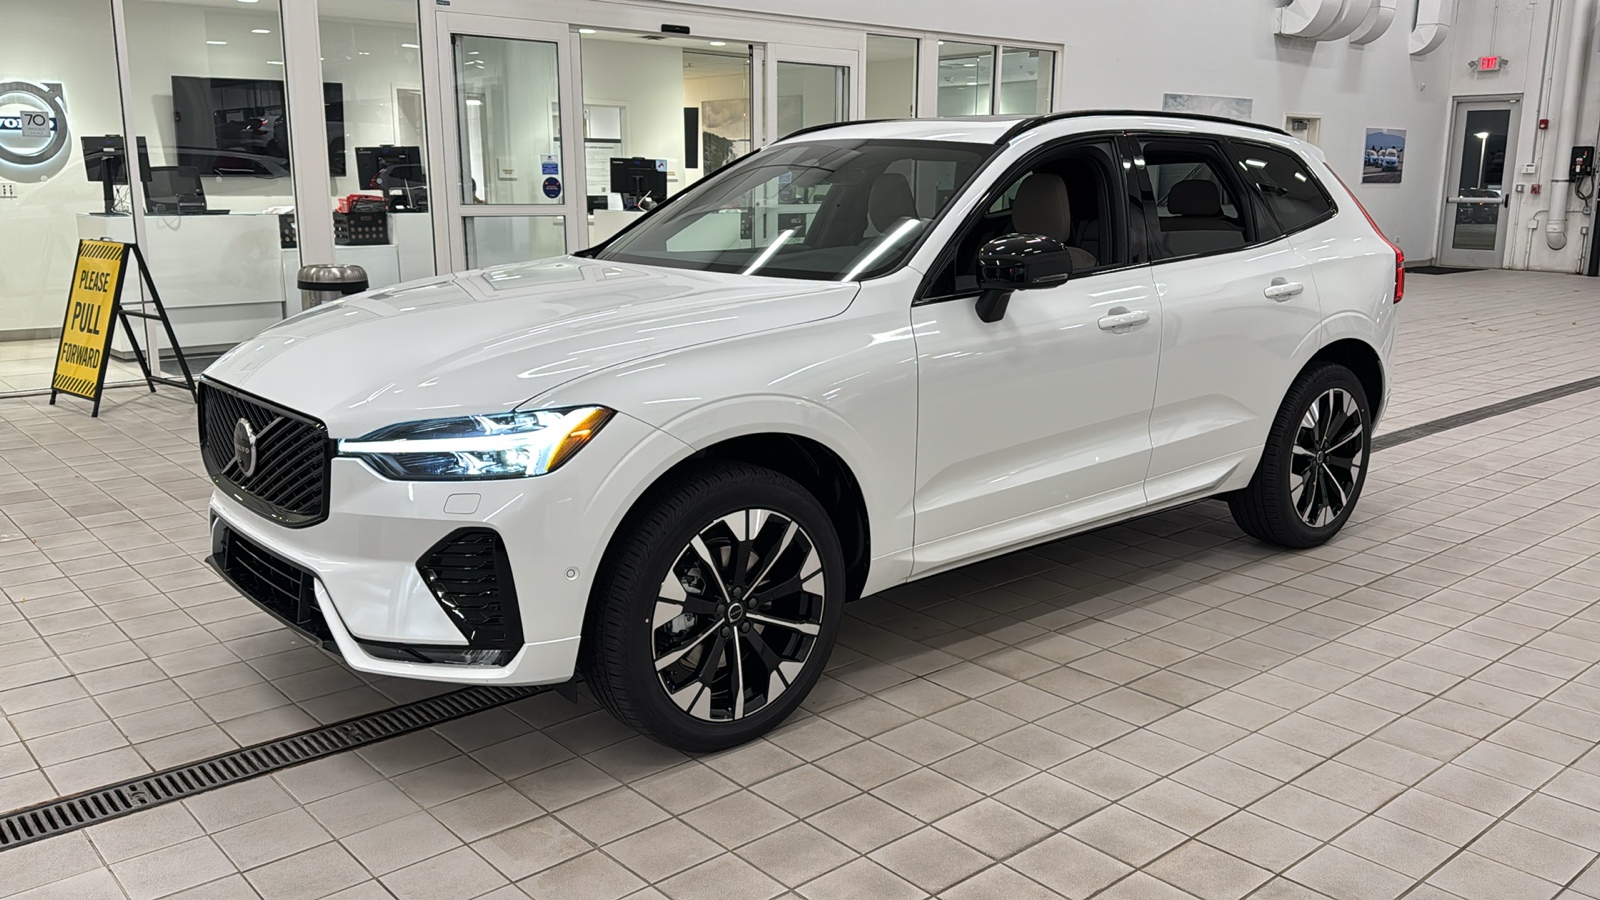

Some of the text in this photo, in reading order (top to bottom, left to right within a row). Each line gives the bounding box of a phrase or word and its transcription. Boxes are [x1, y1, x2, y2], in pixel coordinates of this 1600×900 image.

[24, 114, 46, 126] 70
[79, 270, 110, 293] PLEASE
[71, 301, 101, 335] PULL
[60, 342, 100, 369] FORWARD
